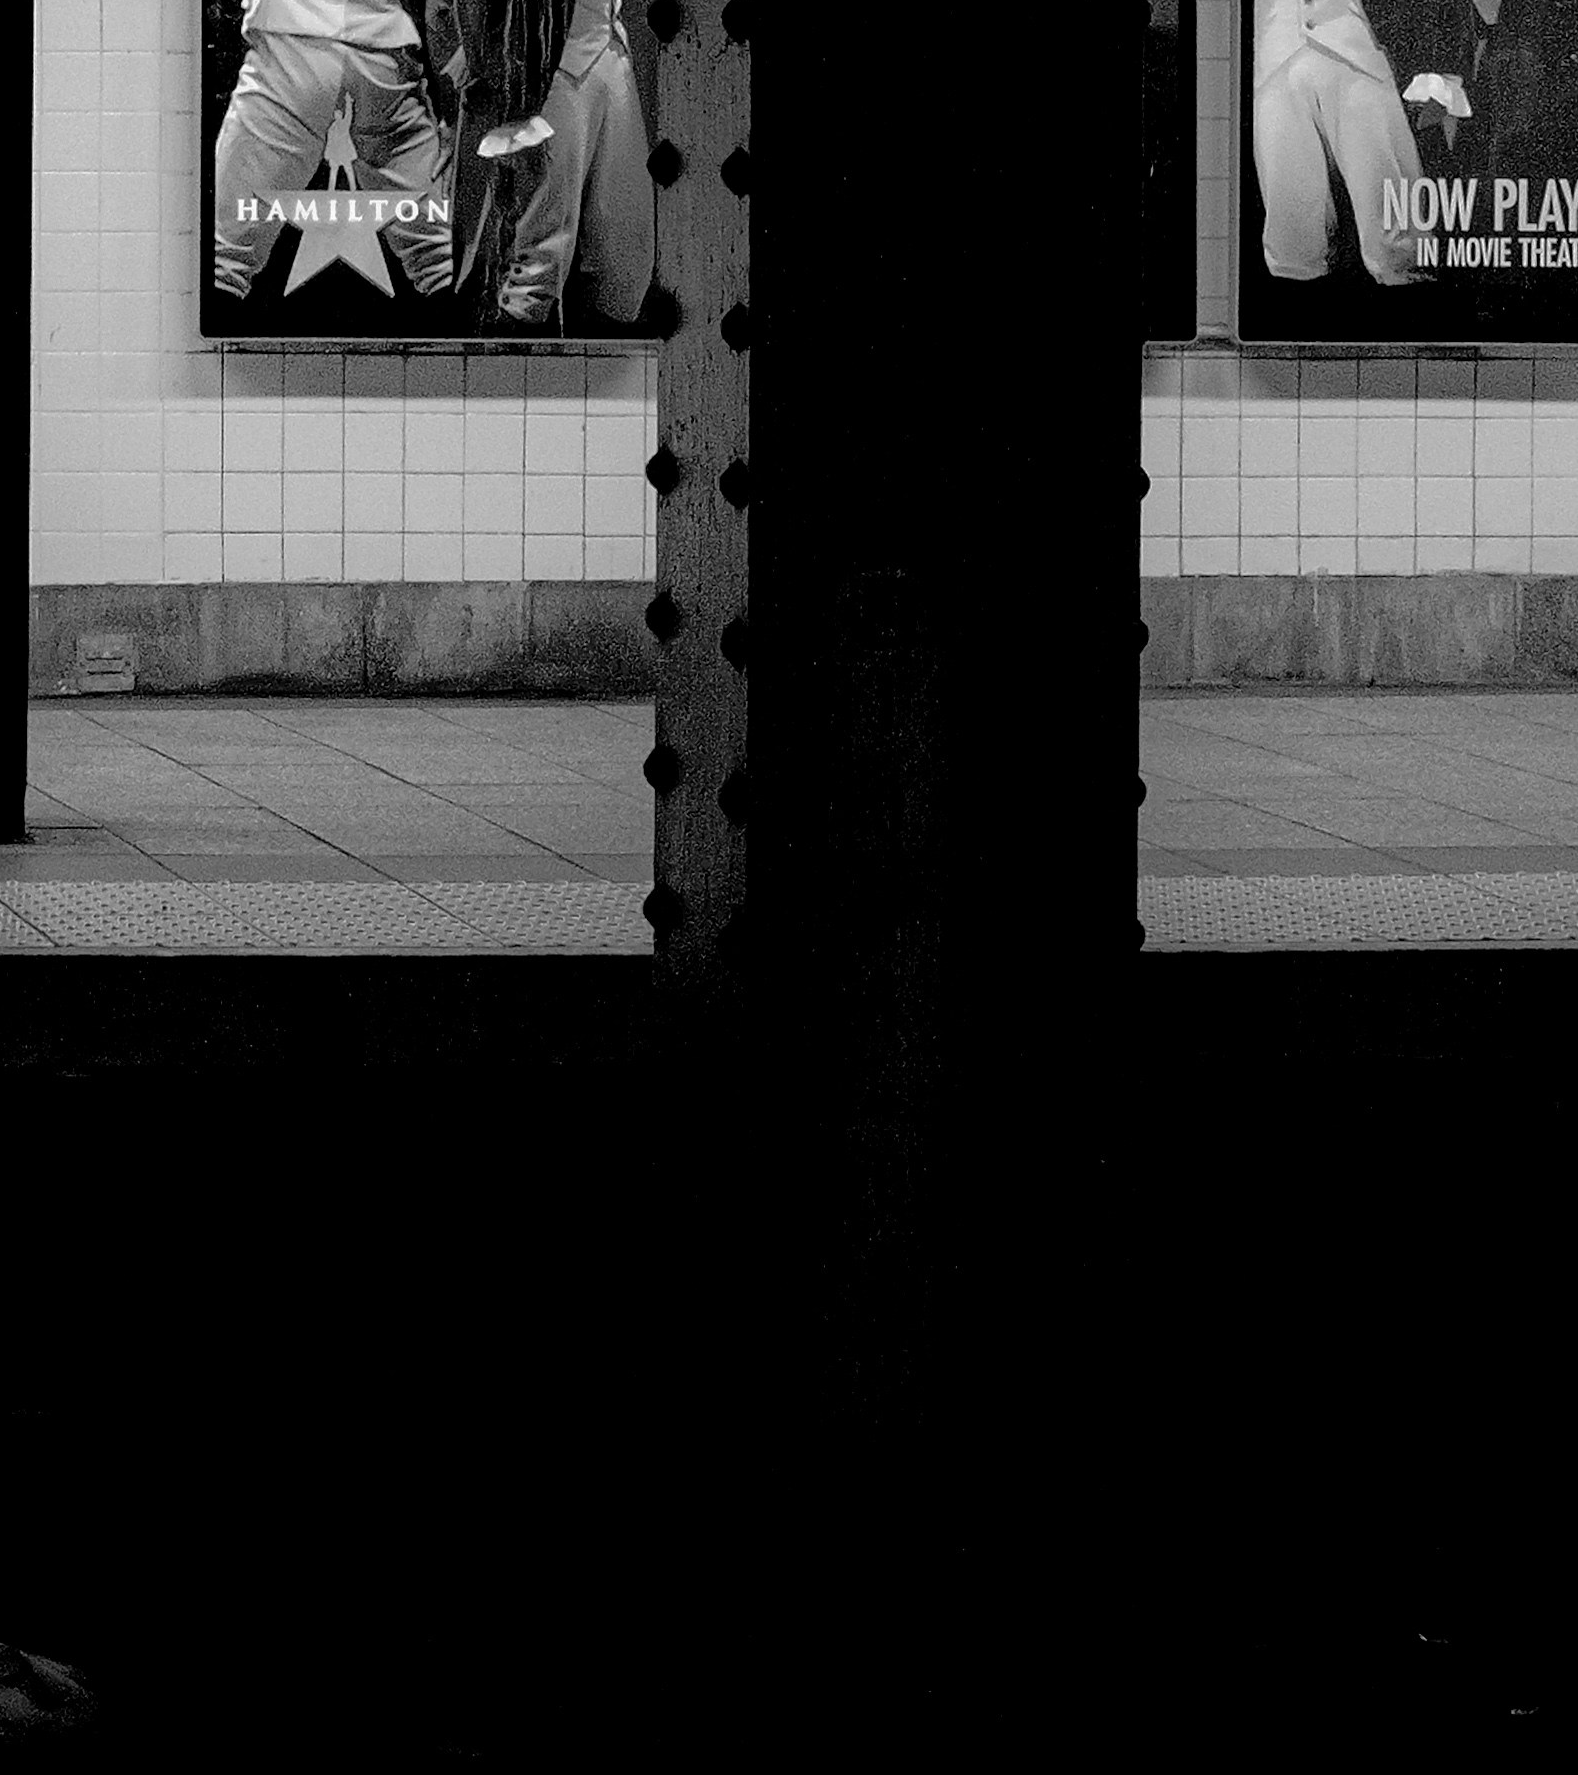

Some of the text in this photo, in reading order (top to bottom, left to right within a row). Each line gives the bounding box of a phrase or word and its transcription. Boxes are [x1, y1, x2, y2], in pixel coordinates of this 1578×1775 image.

[236, 197, 450, 223] HAMILTON
[1382, 177, 1478, 232] NOW
[1417, 237, 1440, 267] IN
[1446, 237, 1513, 268] MOVIE
